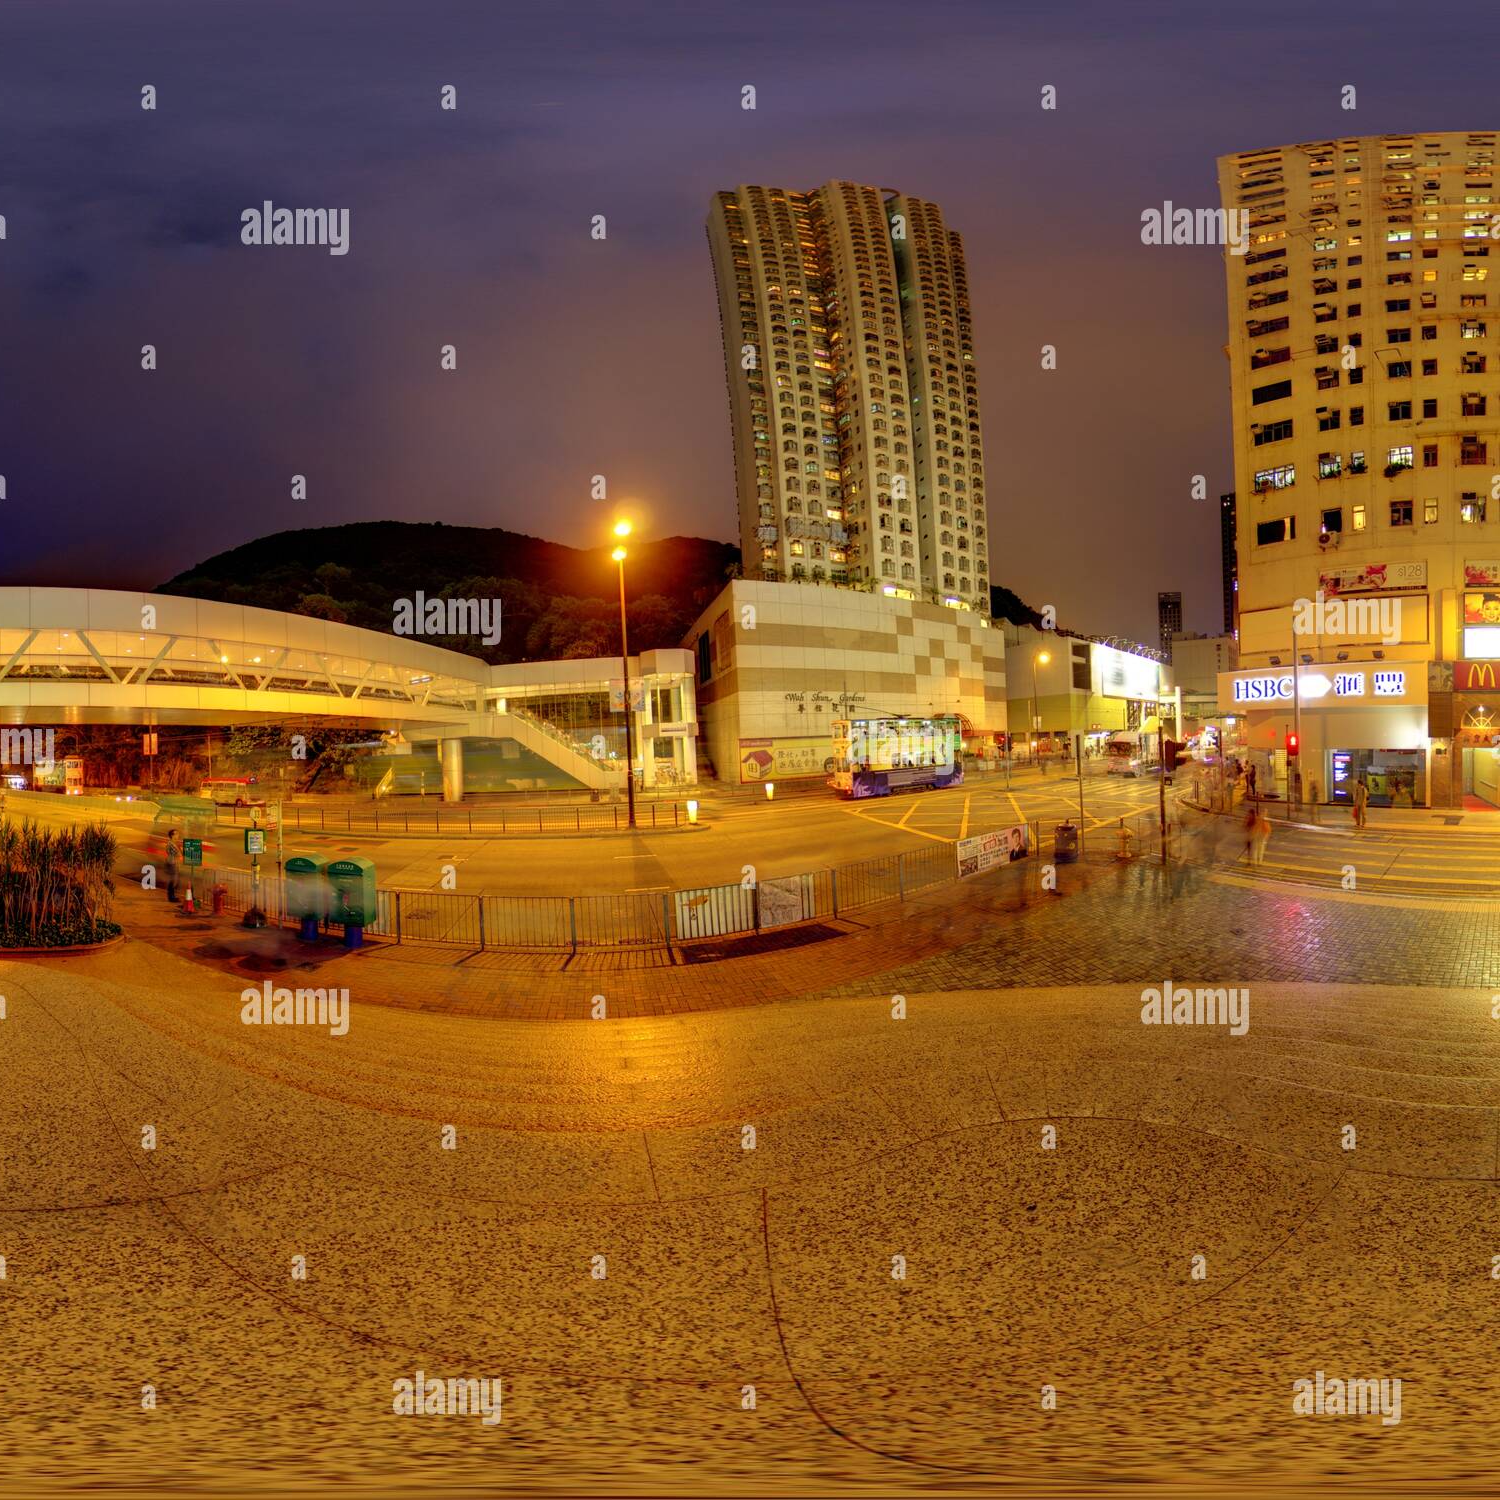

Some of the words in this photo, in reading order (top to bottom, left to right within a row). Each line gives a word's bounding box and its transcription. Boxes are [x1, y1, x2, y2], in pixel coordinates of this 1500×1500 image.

[785, 691, 805, 702] Wah
[811, 691, 833, 702] Shun
[839, 692, 866, 704] Gardens
[1236, 678, 1293, 700] HSBC
